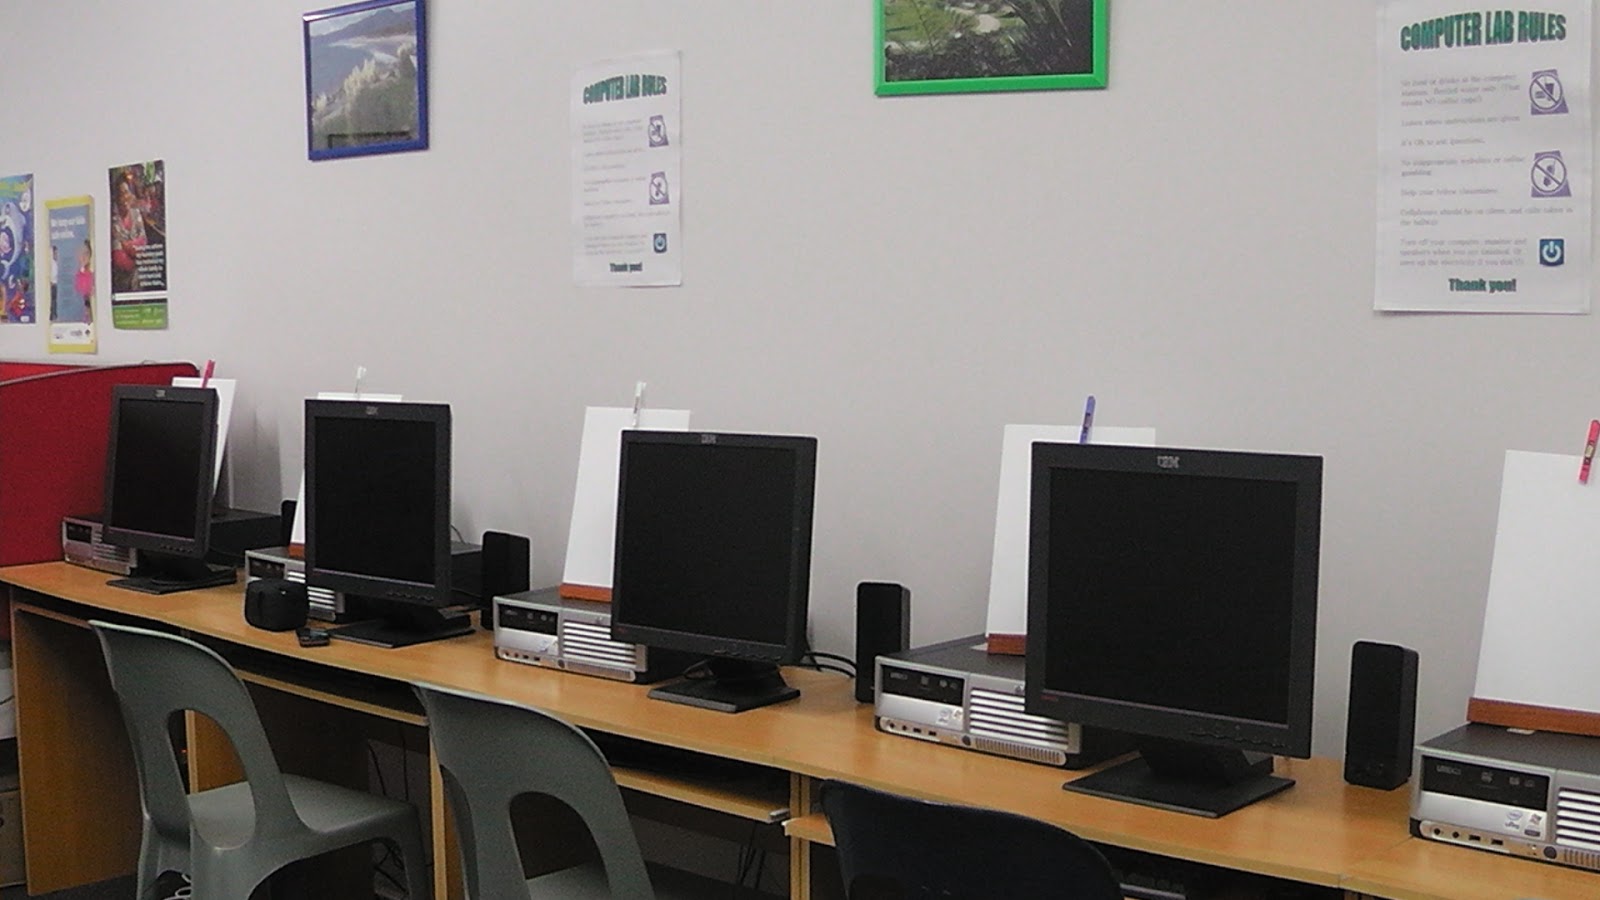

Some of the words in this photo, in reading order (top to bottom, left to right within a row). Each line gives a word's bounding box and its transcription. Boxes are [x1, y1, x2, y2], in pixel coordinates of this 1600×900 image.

[1400, 12, 1482, 51] COMPUTER
[1485, 10, 1514, 45] LAB
[1518, 11, 1567, 43] RULES
[583, 75, 624, 104] COMPUTER
[625, 74, 640, 99] LAB
[641, 74, 667, 97] RULES
[1448, 278, 1486, 292] Thank
[1488, 278, 1517, 293] you!
